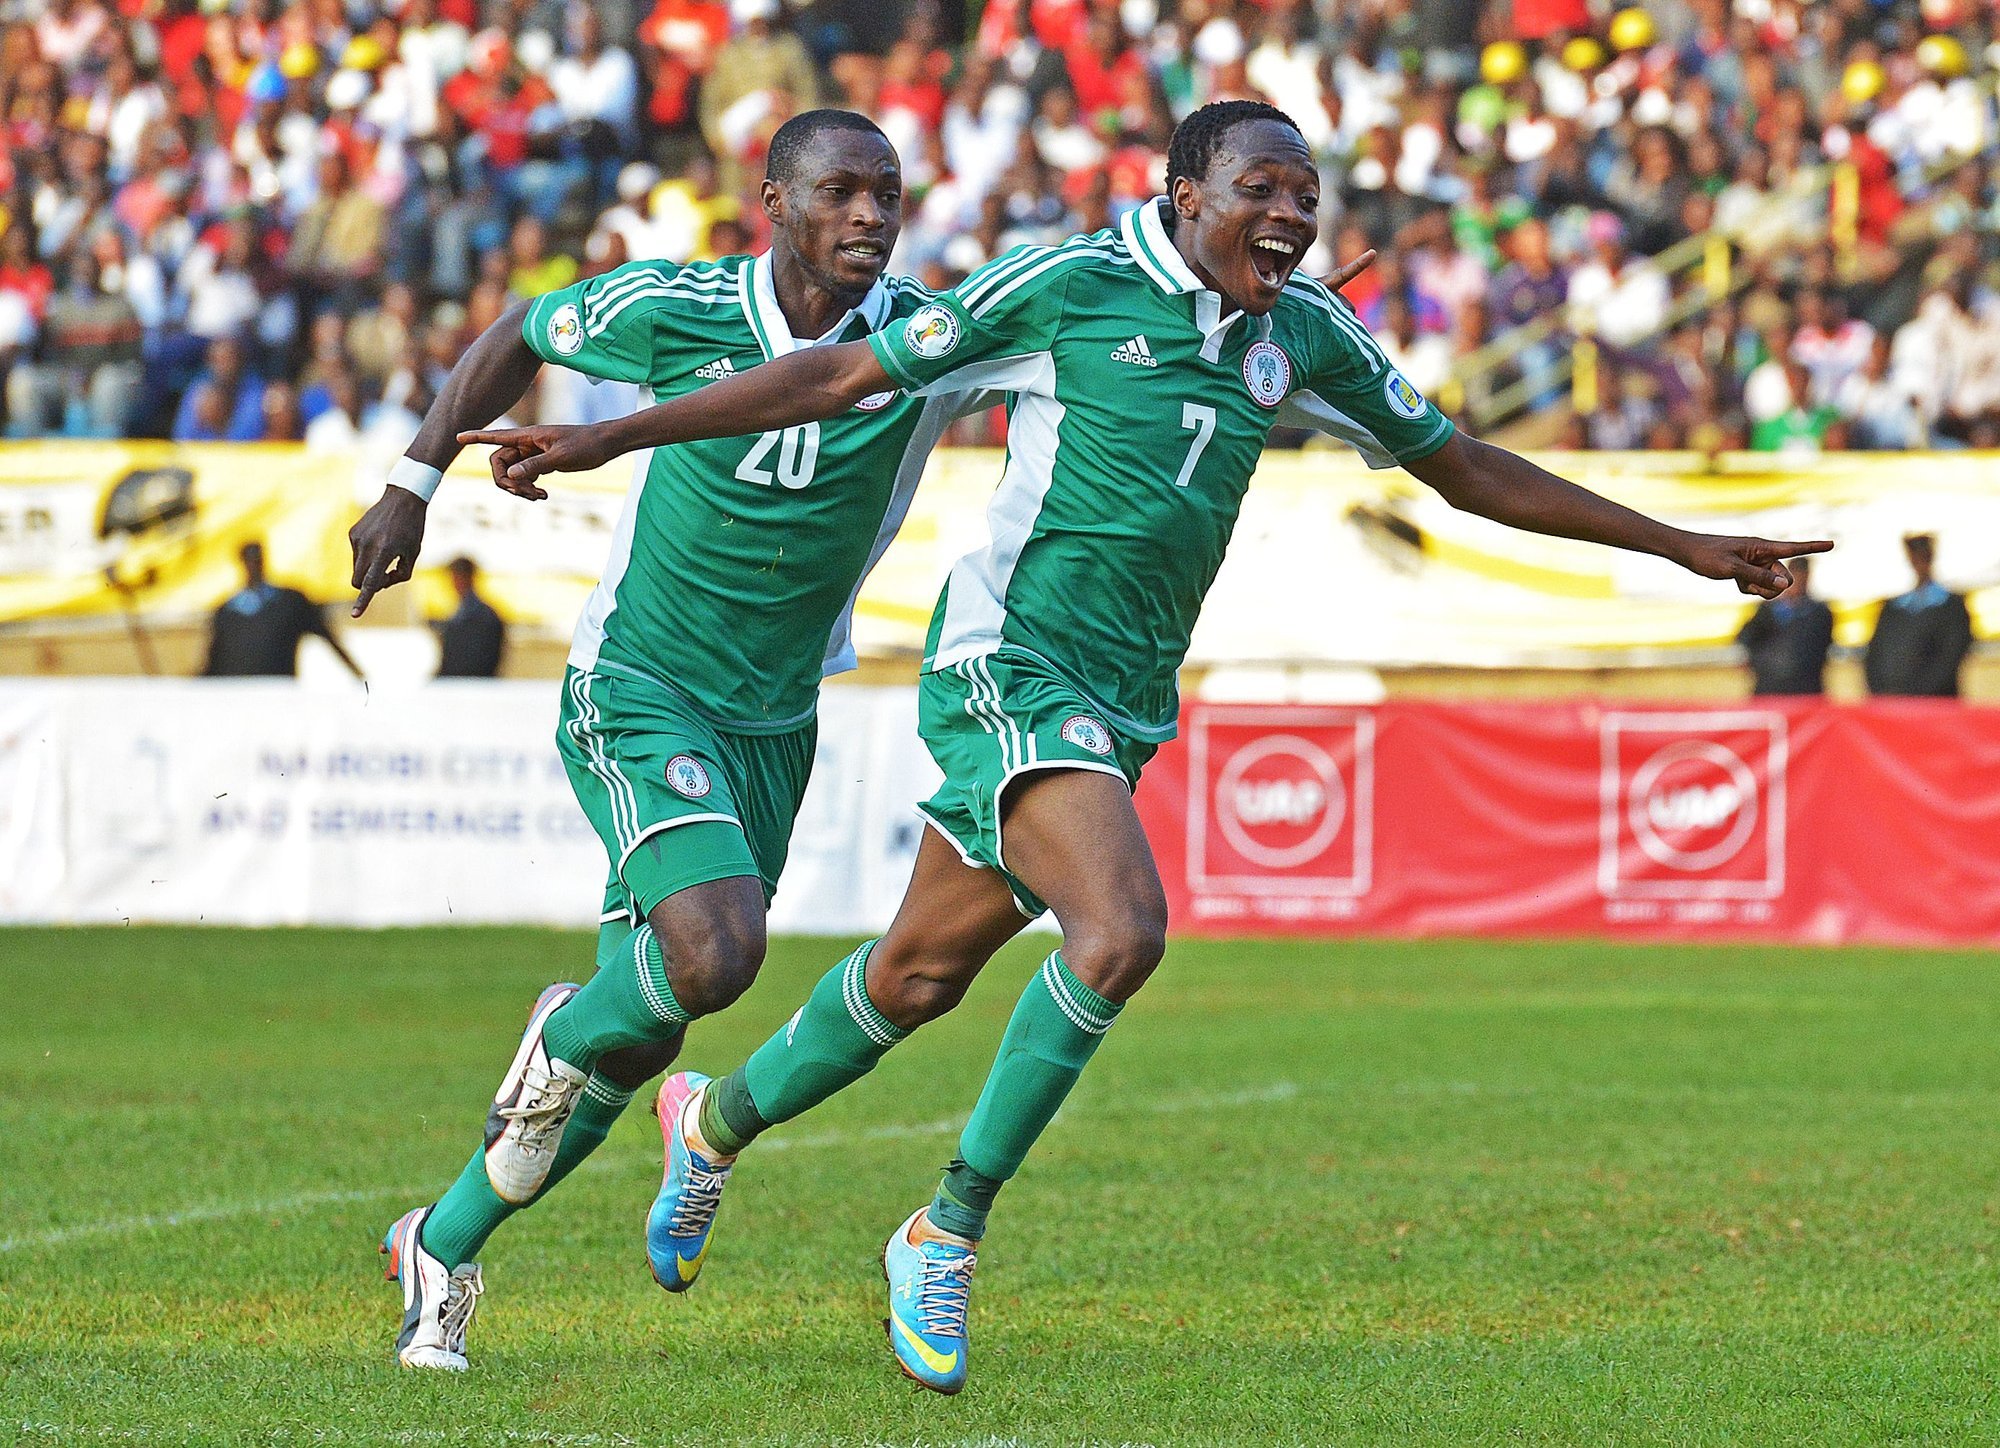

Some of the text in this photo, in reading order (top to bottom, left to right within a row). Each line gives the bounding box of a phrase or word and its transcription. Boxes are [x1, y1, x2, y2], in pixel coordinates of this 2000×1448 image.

[1110, 350, 1158, 368] adidas
[734, 421, 821, 490] 20
[1175, 402, 1217, 488] 7
